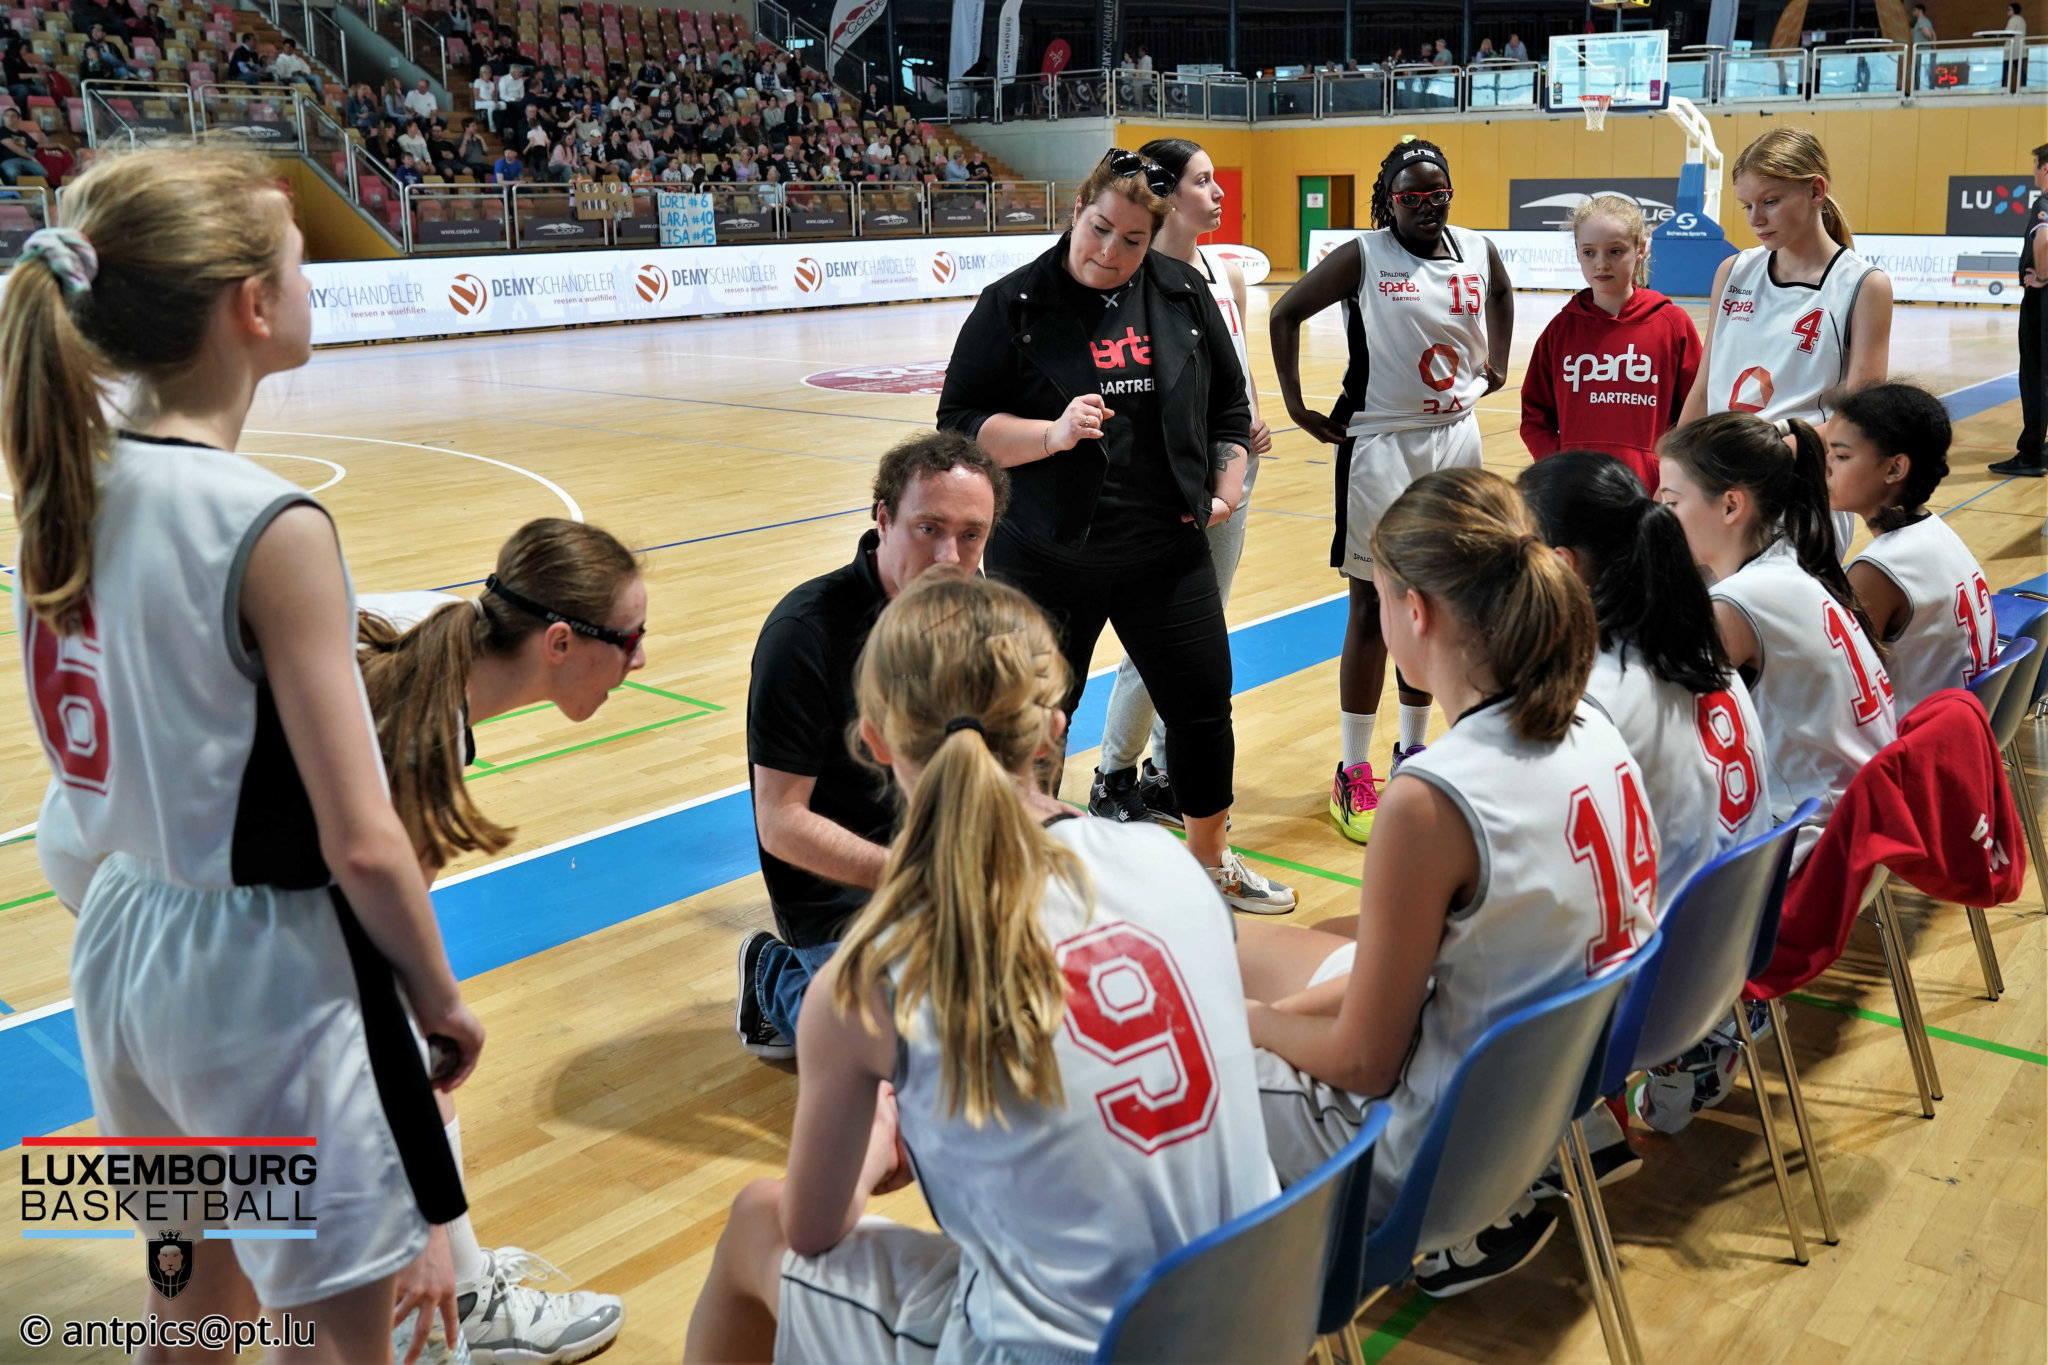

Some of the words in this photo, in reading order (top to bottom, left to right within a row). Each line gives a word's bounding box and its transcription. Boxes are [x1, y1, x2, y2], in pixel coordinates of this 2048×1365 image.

[847, 0, 885, 35] Coque
[659, 194, 686, 209] LORI
[660, 211, 689, 226] LARA
[661, 228, 690, 245] LISA
[672, 264, 777, 287] DEMYSCHANDELER
[825, 257, 918, 278] DEMYSCHANDELER
[1380, 270, 1409, 279] SPALDING
[309, 282, 425, 309] MYSCHANDELER
[491, 272, 616, 298] DEMYSCHANDELER
[1447, 273, 1481, 316] 15
[1728, 285, 1753, 296] SPALDIN
[554, 297, 577, 305] reesen
[584, 294, 617, 303] wuelfillen
[351, 309, 379, 318] reesen
[388, 306, 426, 316] wuelfillen
[1792, 307, 1824, 355] 4
[1589, 391, 1657, 407] BARTRENG
[1693, 686, 1761, 834] 8
[1565, 761, 1658, 977] 14
[1055, 921, 1220, 1156] 9
